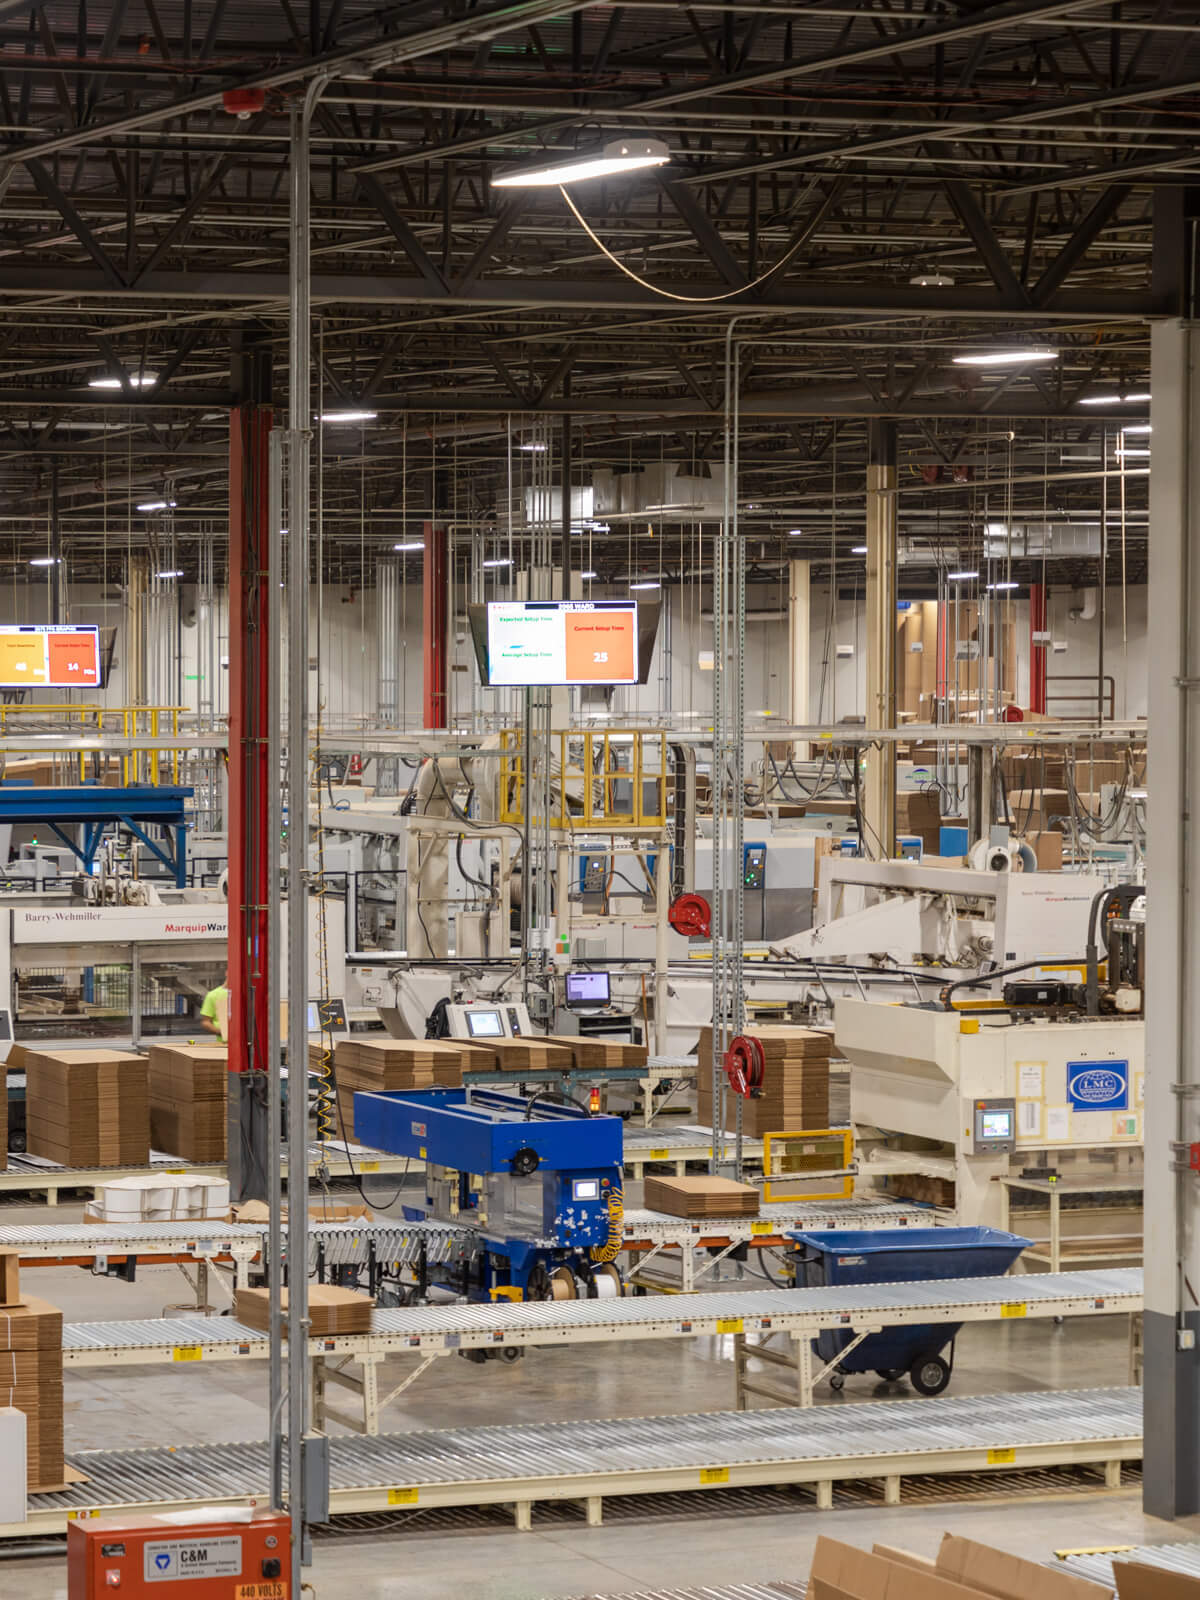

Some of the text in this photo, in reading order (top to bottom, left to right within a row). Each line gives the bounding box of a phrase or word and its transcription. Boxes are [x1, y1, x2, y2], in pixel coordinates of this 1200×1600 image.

[593, 652, 609, 663] 25
[25, 911, 102, 924] Barry-Wehmiller
[1083, 1080, 1113, 1088] LMC
[180, 1549, 208, 1562] C&M
[240, 1583, 282, 1597] 440 VOLTS
